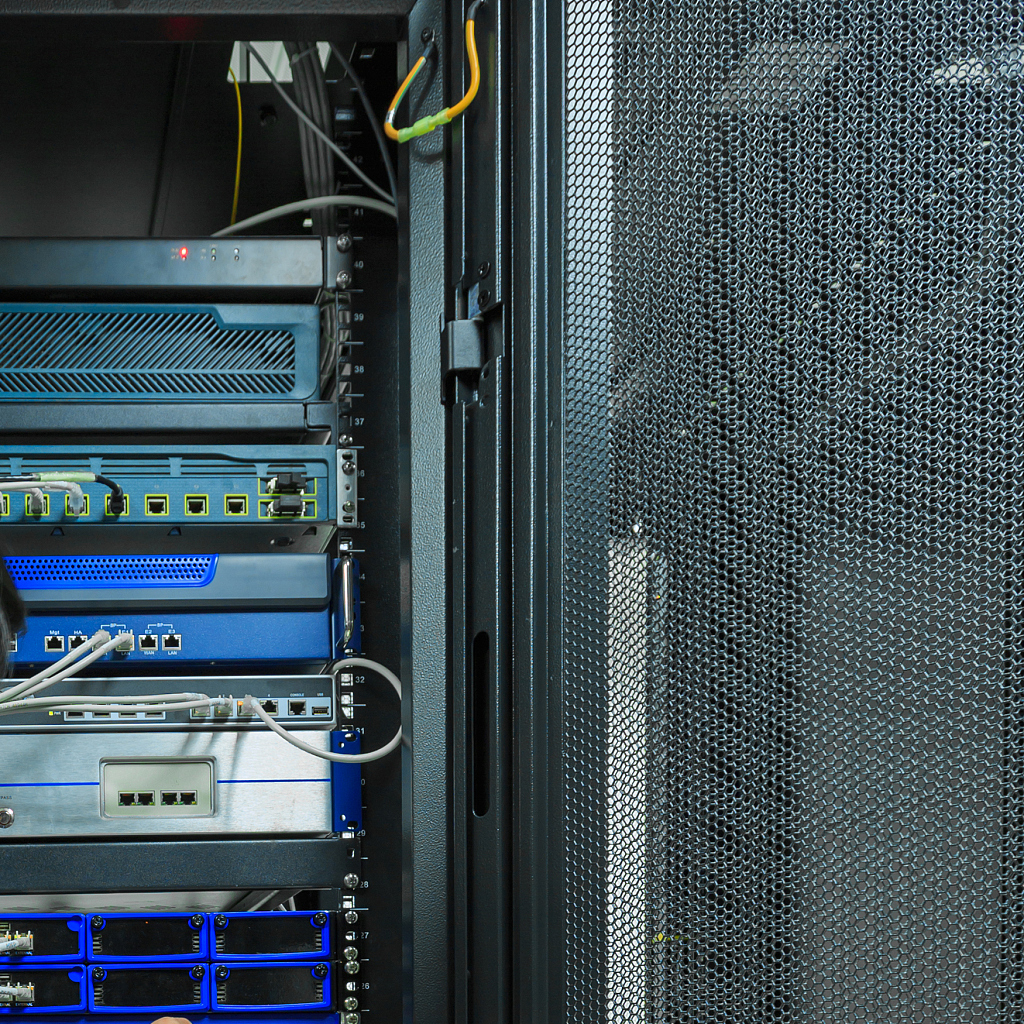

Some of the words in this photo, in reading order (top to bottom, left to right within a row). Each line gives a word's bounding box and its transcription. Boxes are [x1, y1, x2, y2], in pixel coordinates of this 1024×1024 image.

[354, 208, 365, 216] 41
[353, 260, 364, 269] 40
[353, 312, 365, 322] 39
[354, 365, 365, 374] 38
[354, 417, 365, 426] 37
[355, 675, 365, 684] 32
[360, 881, 370, 889] 28
